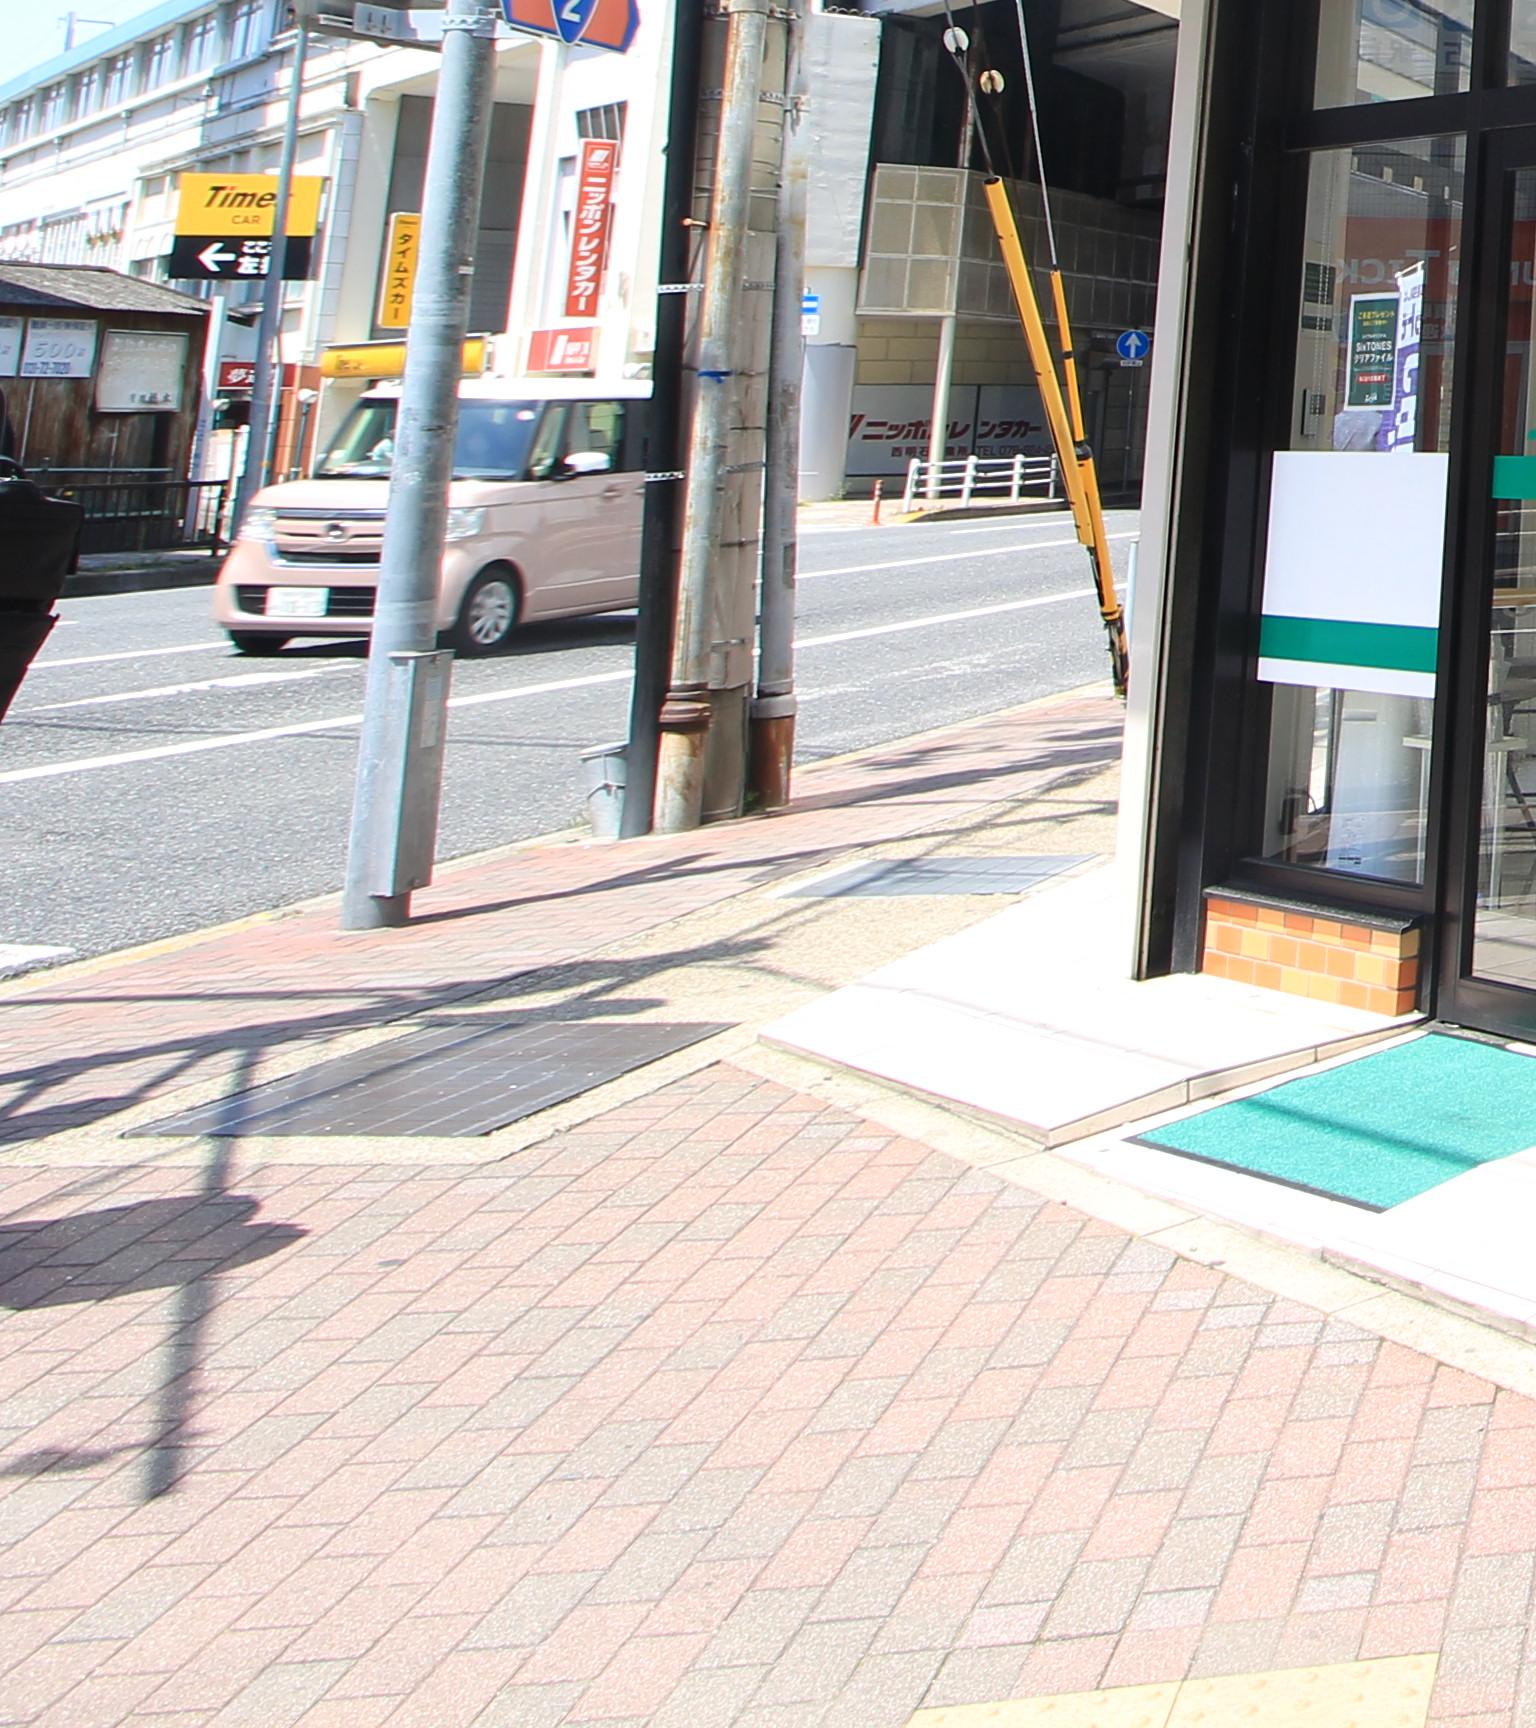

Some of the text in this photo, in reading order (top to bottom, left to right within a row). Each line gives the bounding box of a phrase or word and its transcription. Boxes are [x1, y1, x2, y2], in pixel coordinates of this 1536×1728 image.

[204, 185, 293, 209] Time
[231, 215, 262, 225] CAR
[572, 176, 607, 311] ニッポンレンタカー
[861, 418, 1042, 440] ニッポレンタカー
